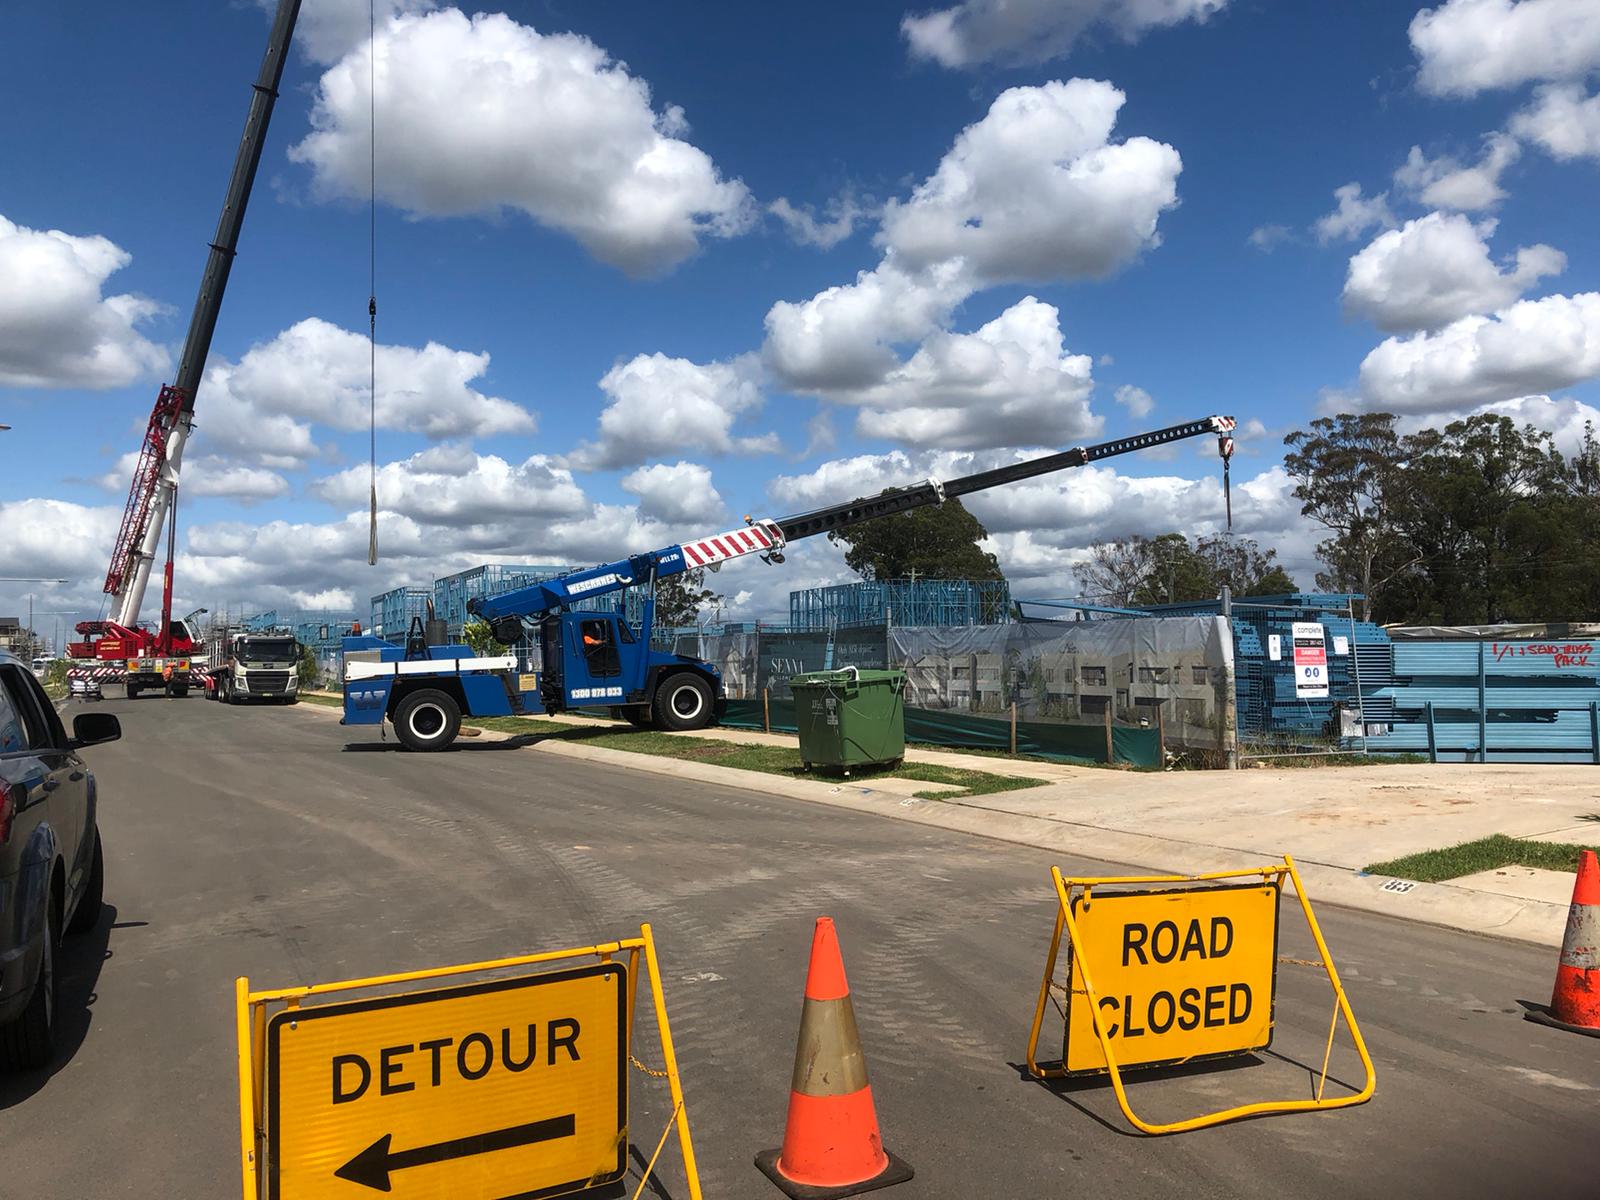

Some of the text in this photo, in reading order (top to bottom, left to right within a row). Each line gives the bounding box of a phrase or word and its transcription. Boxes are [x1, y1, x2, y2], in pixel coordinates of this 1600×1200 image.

[566, 573, 617, 595] WESCRANES
[1297, 626, 1322, 634] complete
[1121, 916, 1234, 967] ROAD
[1093, 982, 1253, 1040] CLOSED
[332, 1017, 581, 1105] DETOUR
